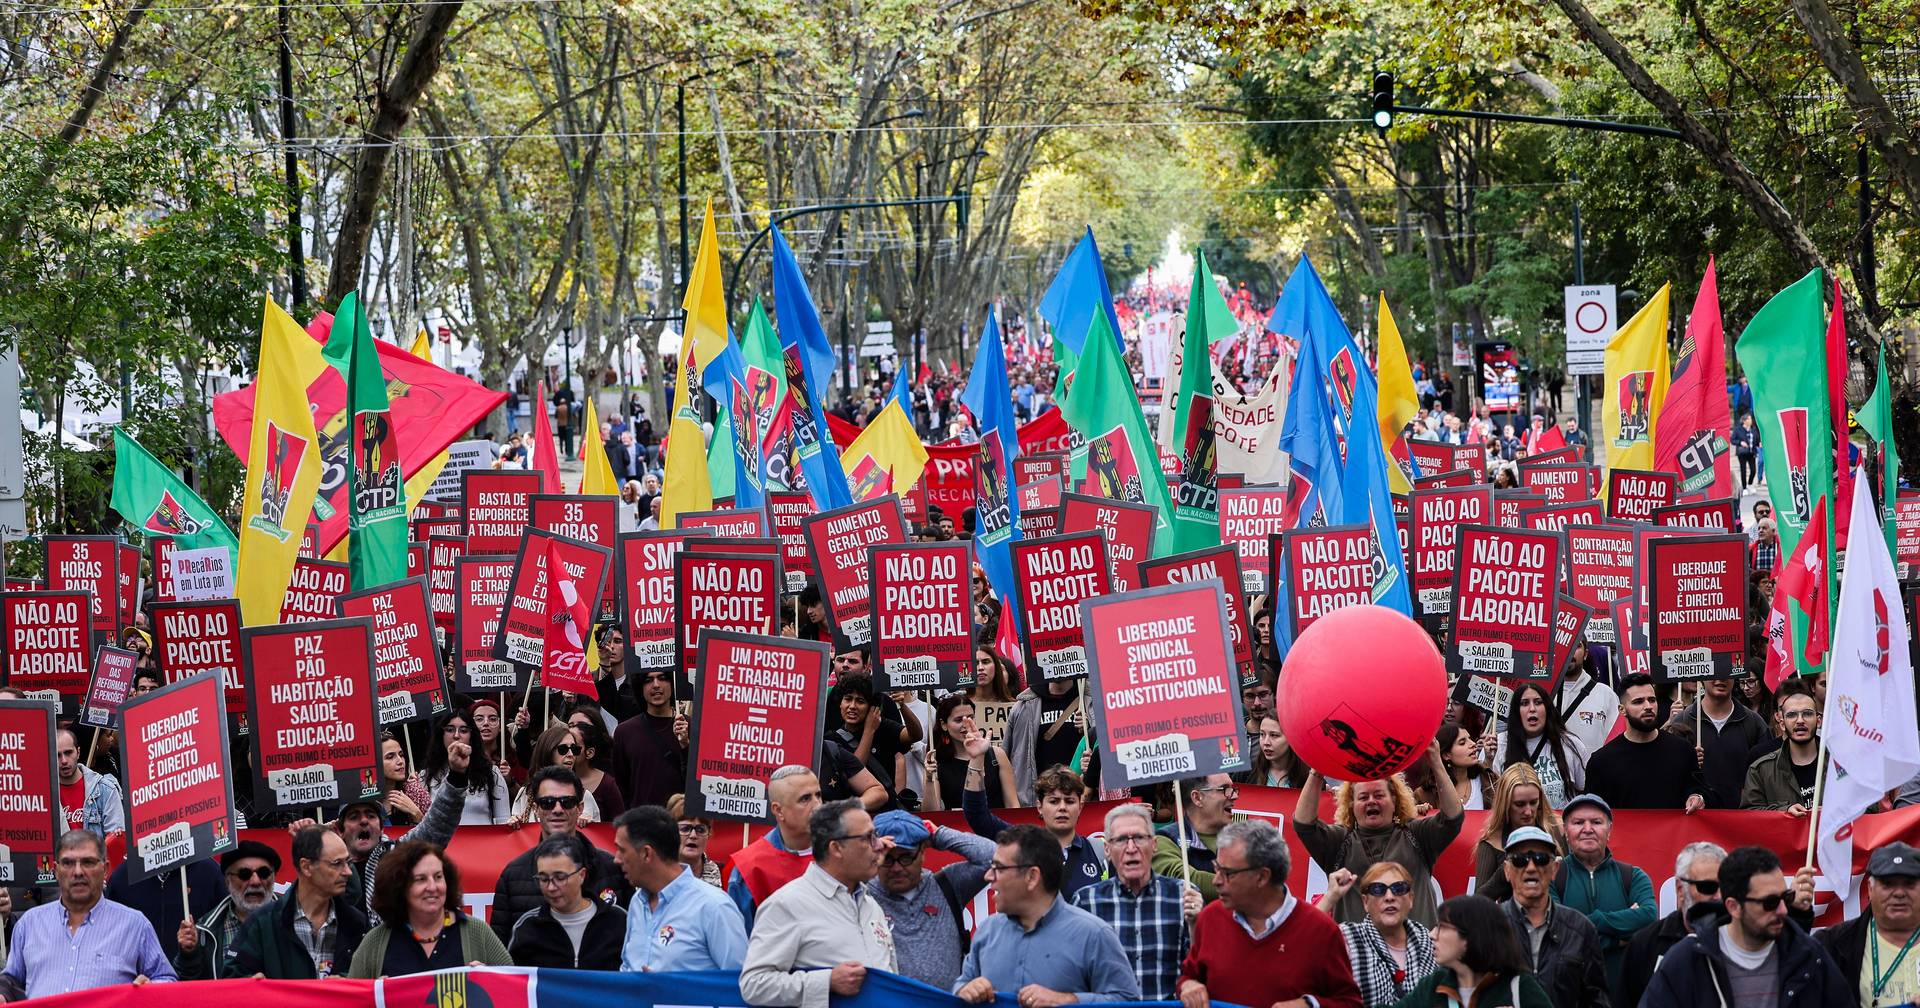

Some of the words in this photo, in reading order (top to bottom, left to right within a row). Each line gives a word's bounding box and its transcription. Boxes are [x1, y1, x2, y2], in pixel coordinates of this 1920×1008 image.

[1024, 462, 1052, 475] DIREITO
[1531, 472, 1578, 485] AUMENTO
[1620, 477, 1646, 497] NÃO
[1649, 481, 1666, 497] AO
[479, 492, 506, 506] BASTA
[509, 492, 526, 506] DE
[1026, 488, 1038, 499] PAZ
[1545, 487, 1564, 500] DAS
[564, 504, 584, 522] 35
[1026, 498, 1041, 510] PÃO
[1228, 496, 1260, 517] NÃO
[1262, 497, 1282, 515] AO
[1422, 497, 1455, 522] NÃO
[1459, 498, 1480, 520] AO
[1501, 502, 1518, 514] PAZ
[827, 510, 880, 536] AUMENTO
[1096, 508, 1119, 525] PAZ
[1501, 514, 1518, 528] PÃO
[1535, 514, 1568, 530] NÃO
[1573, 512, 1592, 526] AO
[550, 524, 599, 543] HORAS
[1226, 518, 1283, 537] PACOTE
[828, 534, 860, 554] GERAL
[861, 525, 889, 546] DOS
[1573, 538, 1632, 554] CONTRATAÇÃO
[72, 543, 88, 560] 35
[788, 546, 806, 558] NÃO!
[1301, 536, 1340, 564] NÃO
[1345, 537, 1370, 562] AO
[1472, 536, 1514, 566] NÃO
[1518, 543, 1545, 569] AO
[1573, 552, 1616, 567] COLETIVA,
[178, 556, 224, 575] PRecáRios
[886, 554, 925, 582] NÃO
[930, 554, 956, 580] AO
[1027, 547, 1065, 576] NÃO
[1070, 544, 1094, 570] AO
[1672, 560, 1727, 576] LIBERDADE
[60, 561, 102, 579] HORAS
[289, 566, 320, 590] NÃO
[322, 572, 344, 593] AO
[479, 566, 492, 578] UM
[692, 563, 730, 592] NÃO
[736, 567, 762, 593] AO
[1167, 560, 1216, 585] SMN
[1302, 563, 1372, 591] PACOTE
[180, 579, 192, 591] em
[194, 576, 210, 589] Luta
[213, 576, 224, 590] por
[471, 580, 482, 592] DE
[1030, 572, 1100, 606] PACOTE
[1468, 568, 1545, 598] PACOTE
[1578, 573, 1632, 590] CADUCIDADE,
[1678, 576, 1722, 592] SINDICAL
[372, 594, 394, 612] PAZ
[886, 584, 959, 611] PACOTE
[1597, 588, 1617, 602] NÃO!
[1677, 594, 1684, 608] É
[1686, 592, 1724, 606] DIREITO
[14, 600, 50, 625] NÃO
[55, 602, 78, 623] AO
[691, 596, 764, 622] PACOTE
[837, 605, 856, 618] OUTRO
[1459, 597, 1548, 628] LABORAL
[1658, 606, 1742, 625] CONSTITUCIONAL
[164, 612, 201, 638] NÃO
[205, 612, 228, 637] AO
[376, 610, 398, 630] PÃO
[880, 612, 968, 640] LABORAL
[1589, 620, 1612, 631] SALÁRIO
[14, 626, 80, 650] PACOTE
[633, 629, 656, 638] OUTRO
[658, 628, 673, 638] RUMO
[1118, 616, 1196, 644] LIBERDADE
[1460, 628, 1482, 638] OUTRO
[1484, 628, 1502, 639] RUMO
[1512, 630, 1545, 642] POSSÍVEL!
[166, 640, 234, 666] PACOTE
[294, 636, 324, 656] PAZ
[376, 643, 410, 664] SAÚDE
[1128, 638, 1193, 664] SINDICAL
[1471, 646, 1504, 658] SALÁRIO
[10, 652, 88, 676] LABORAL
[104, 654, 132, 668] AUMENTO
[731, 646, 752, 665] UM
[754, 650, 796, 670] POSTO
[897, 659, 930, 671] SALÁRIO
[1048, 650, 1078, 664] SALÁRIO
[1474, 658, 1509, 671] DIREITOS
[1674, 651, 1704, 664] SALÁRIO
[108, 666, 122, 678] DAS
[296, 658, 326, 678] PÃO
[478, 664, 507, 674] SALÁRIO
[1054, 660, 1086, 674] DIREITOS
[1129, 664, 1138, 684] É
[1141, 658, 1196, 682] DIREITO
[1677, 662, 1710, 676] DIREITOS
[96, 676, 128, 691] REFORMAS
[480, 676, 512, 686] DIREITOS
[718, 665, 736, 683] DE
[738, 668, 805, 691] TRABALHO
[901, 672, 936, 684] DIREITOS
[93, 689, 98, 700] E
[99, 688, 125, 704] PENSÕES
[271, 678, 354, 704] HABITAÇÃO
[1106, 676, 1226, 710] CONSTITUCIONAL
[290, 700, 338, 725] SAÚDE
[382, 706, 412, 722] DIREITOS
[141, 708, 200, 743] LIBERDADE
[730, 722, 784, 746] VÍNCULO
[277, 722, 355, 749] EDUCAÇÃO
[148, 730, 196, 761] SINDICAL
[724, 742, 784, 765] EFECTIVO
[1136, 740, 1179, 759] SALÁRIO
[148, 760, 155, 780] É
[156, 748, 198, 777] DIREITO
[266, 752, 294, 766] OUTRO
[296, 750, 320, 764] RUMO
[328, 746, 370, 760] POSSÍVEL!
[1142, 756, 1189, 774] DIREITOS
[702, 760, 728, 772] OUTRO
[730, 762, 754, 774] RUMO
[132, 762, 220, 807] CONSTITUCIONAL
[284, 770, 324, 786] SALÁRIO
[290, 786, 332, 801] DIREITOS
[716, 782, 756, 798] SALÁRIO
[136, 817, 158, 834] OUTRO
[160, 812, 178, 828] RUMO
[184, 796, 221, 819] POSSÍVEL!
[719, 799, 761, 816] DIREITOS
[4, 830, 48, 842] POSSÍVEL!
[150, 830, 184, 850] SALÁRIO
[155, 843, 190, 864] DIREITOS
